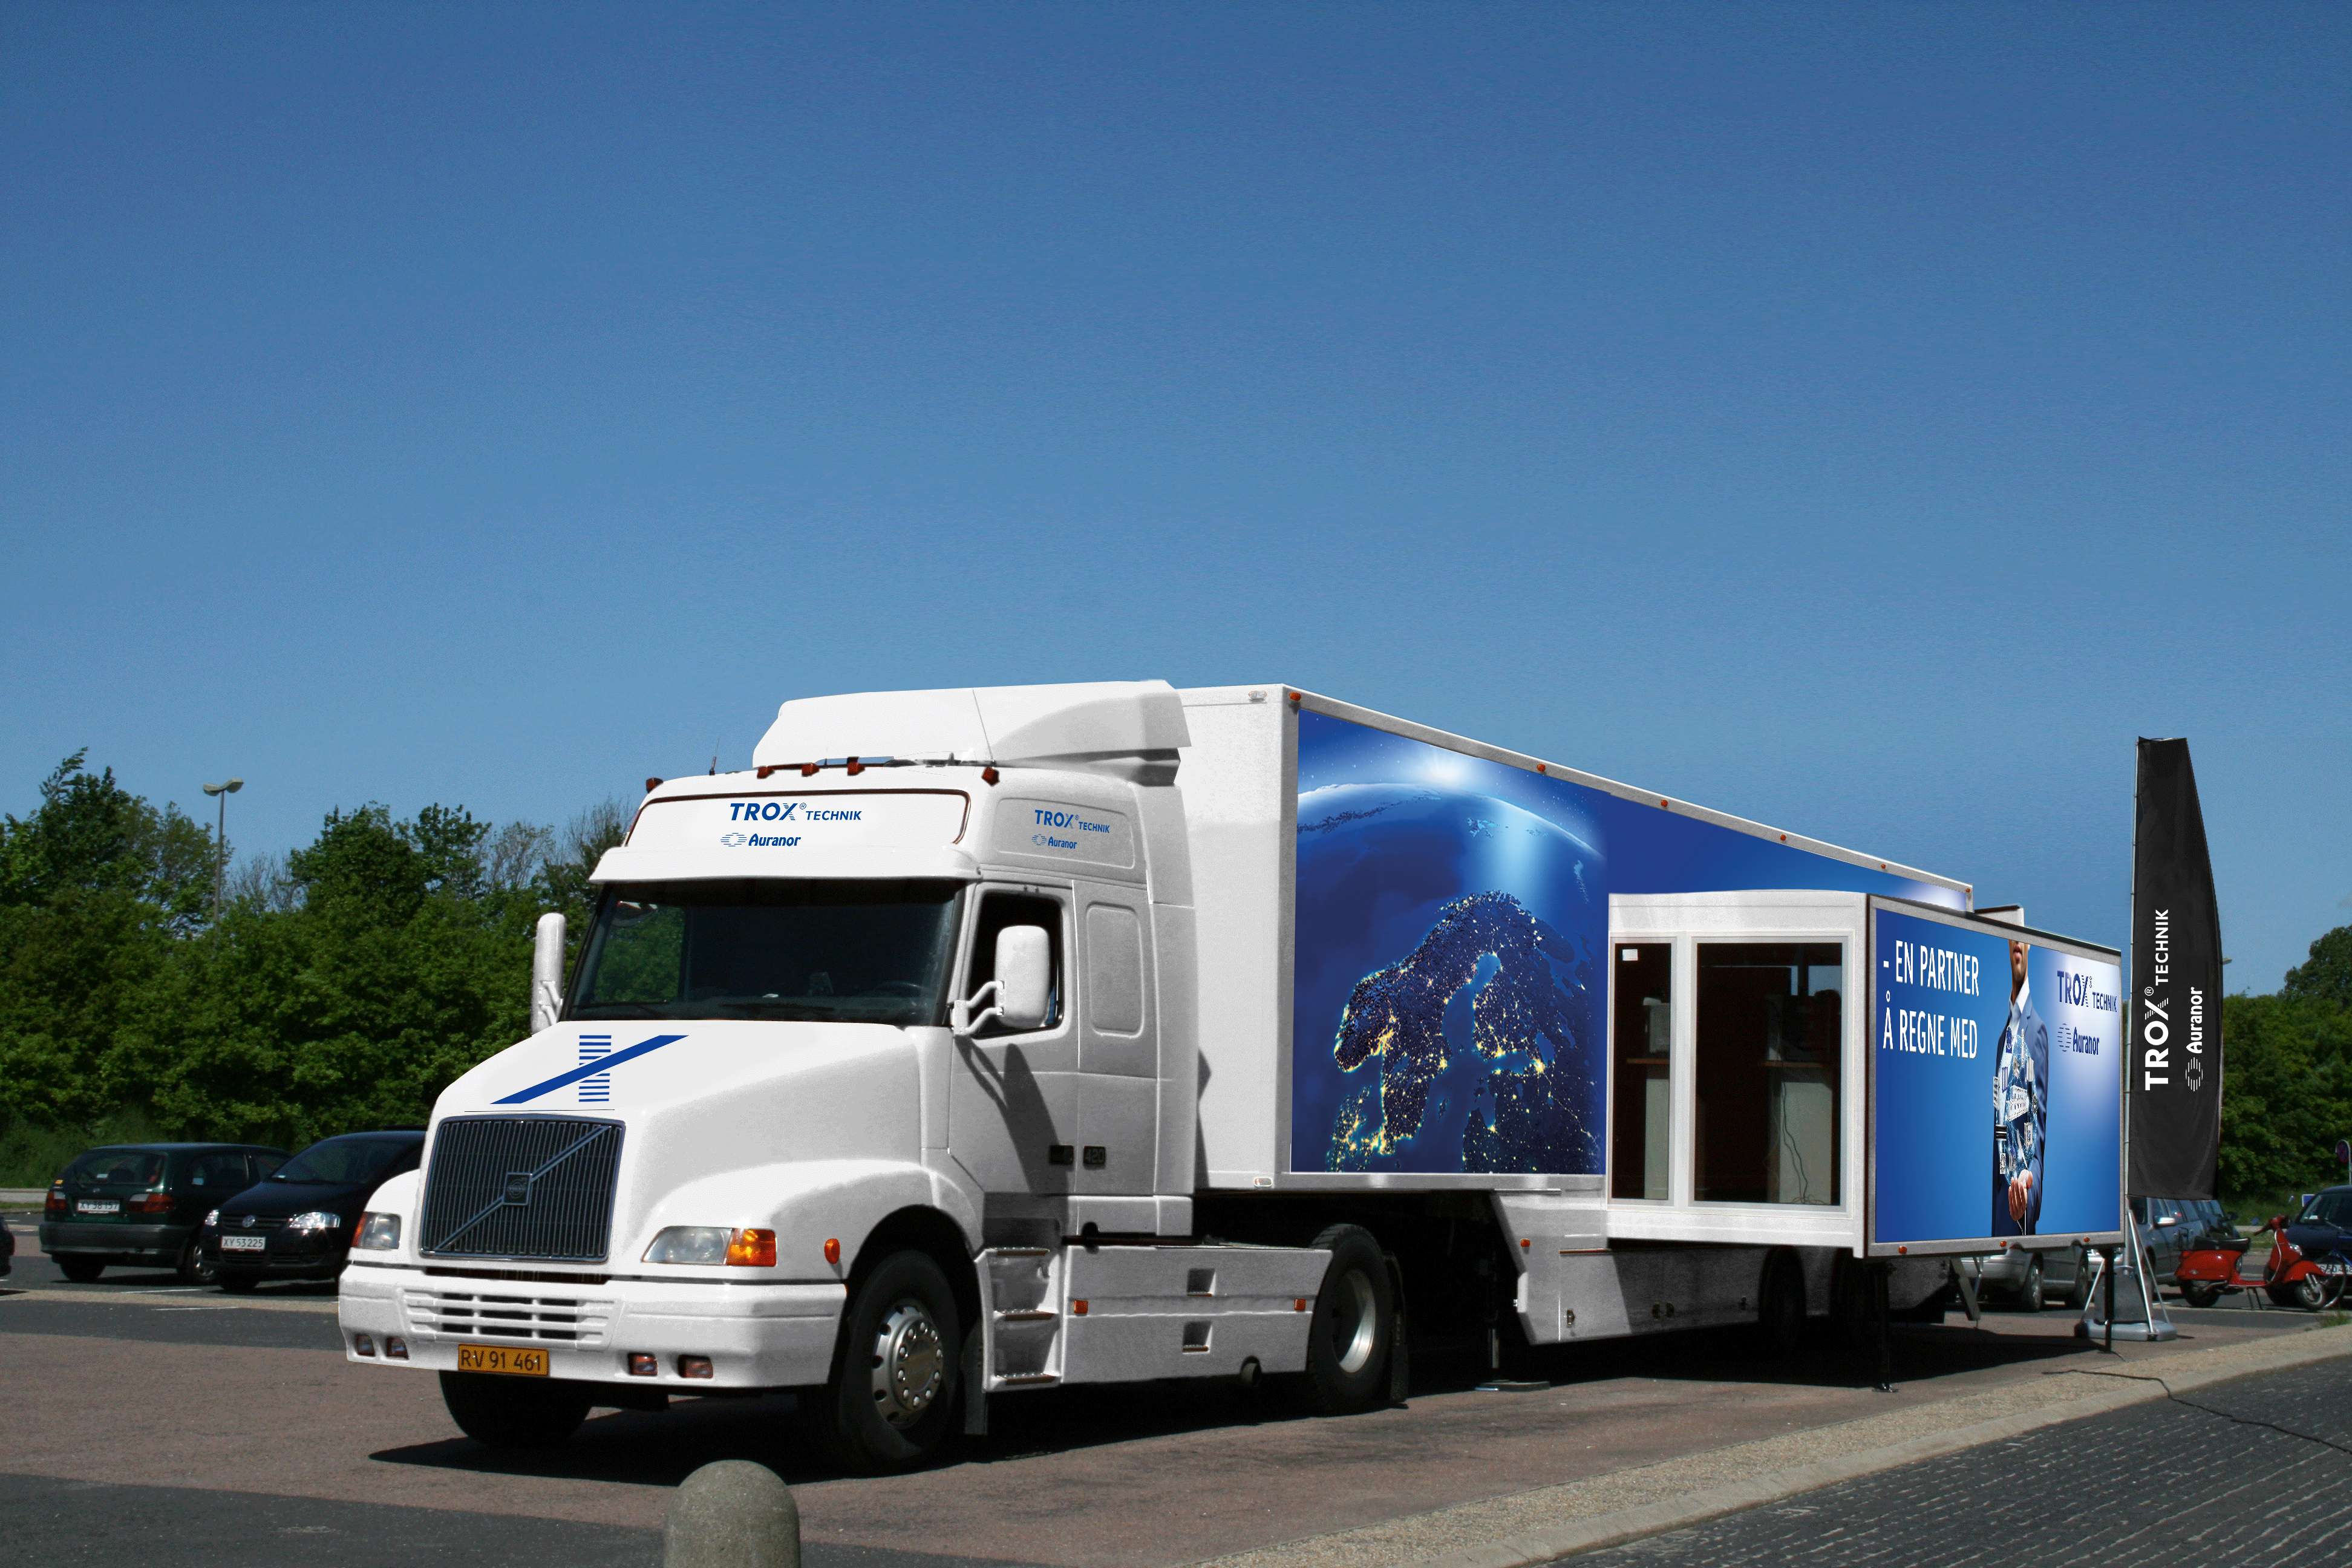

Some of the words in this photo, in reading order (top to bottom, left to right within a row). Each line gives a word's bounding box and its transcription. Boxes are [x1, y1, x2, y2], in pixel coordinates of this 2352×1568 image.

[806, 811, 862, 821] TECHNIK
[1079, 822, 1110, 833] TECHNIK
[748, 834, 801, 846] Auranor
[1048, 836, 1077, 849] Auranor
[2155, 909, 2169, 986] TECHNIK
[1896, 940, 1913, 984] EN
[1920, 945, 1979, 997] PARTNER
[2092, 991, 2117, 1012] TECHNIK
[1883, 990, 1893, 1050] Å
[1900, 1009, 1945, 1056] REGNE
[1950, 1017, 1978, 1059] MED
[2186, 987, 2203, 1054] Auranor
[2073, 1027, 2100, 1056] Auranor
[460, 1349, 485, 1368] RV
[489, 1350, 506, 1369] 91
[514, 1353, 541, 1371] 461
